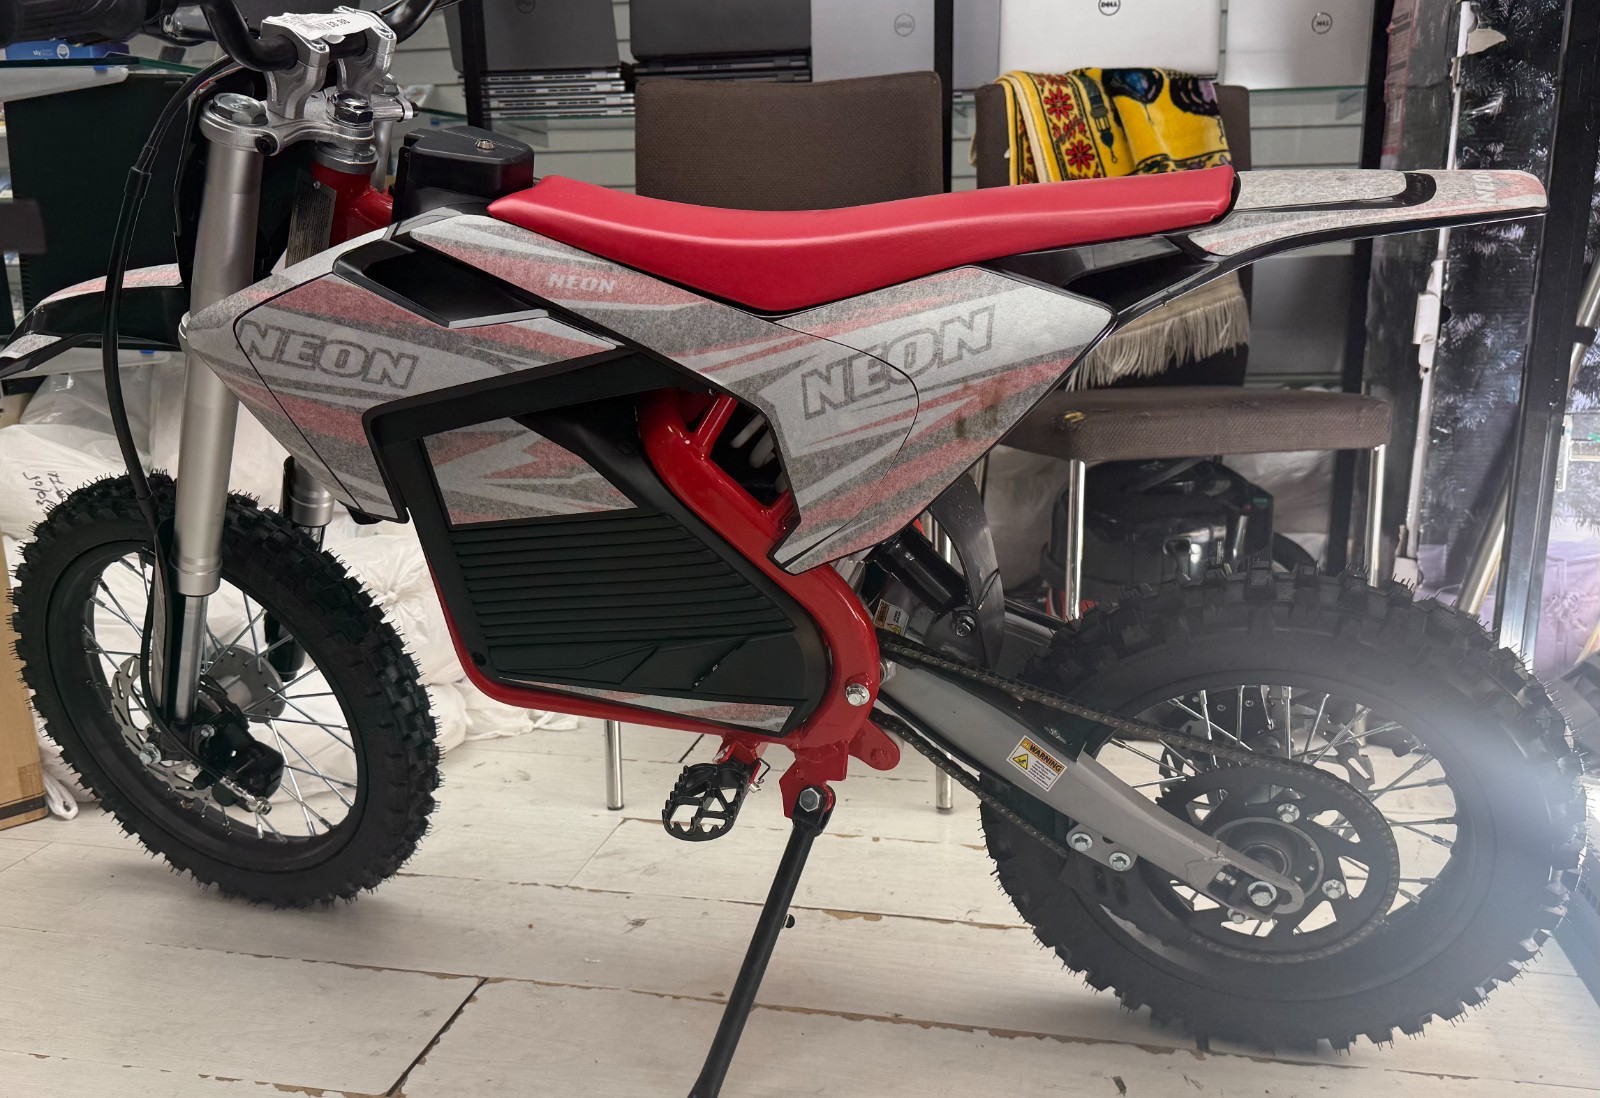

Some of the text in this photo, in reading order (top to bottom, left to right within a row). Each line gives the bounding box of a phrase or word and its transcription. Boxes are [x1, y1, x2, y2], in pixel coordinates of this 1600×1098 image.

[548, 273, 616, 294] NEON
[235, 319, 420, 390] NEON
[801, 303, 996, 420] NEON
[1029, 744, 1064, 773] WARNING
